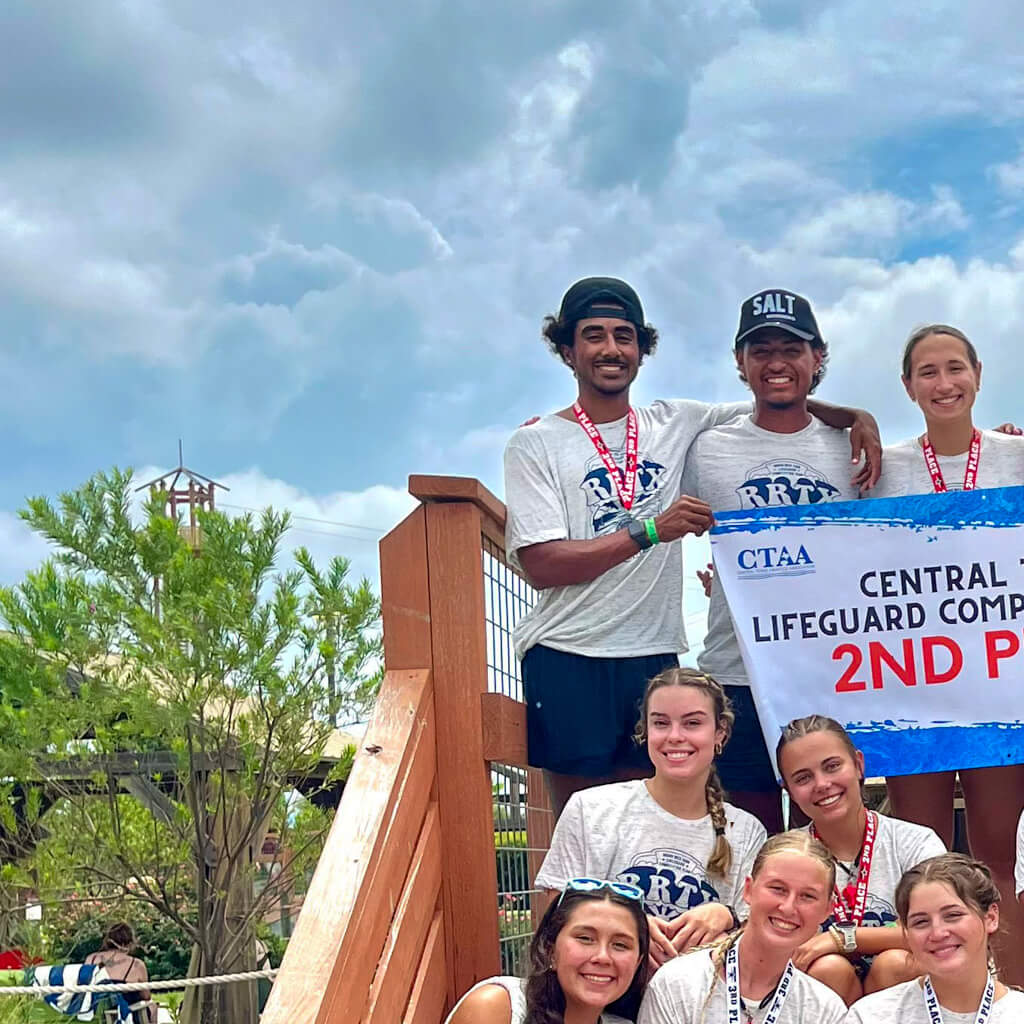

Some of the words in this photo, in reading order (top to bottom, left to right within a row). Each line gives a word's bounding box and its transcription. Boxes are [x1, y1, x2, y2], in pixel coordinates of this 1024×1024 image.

[753, 293, 796, 316] SALT
[925, 446, 939, 475] PLACE
[968, 442, 981, 471] PLACE
[737, 544, 814, 570] CTAA
[860, 561, 1008, 598] CENTRAL
[752, 602, 926, 643] LIFEGUARD
[832, 635, 963, 693] 2ND
[862, 844, 871, 864] 2ND
[853, 882, 867, 917] PLACE
[728, 985, 738, 1005] 3RD
[778, 976, 790, 997] 3RD
[981, 983, 994, 1017] PLACE
